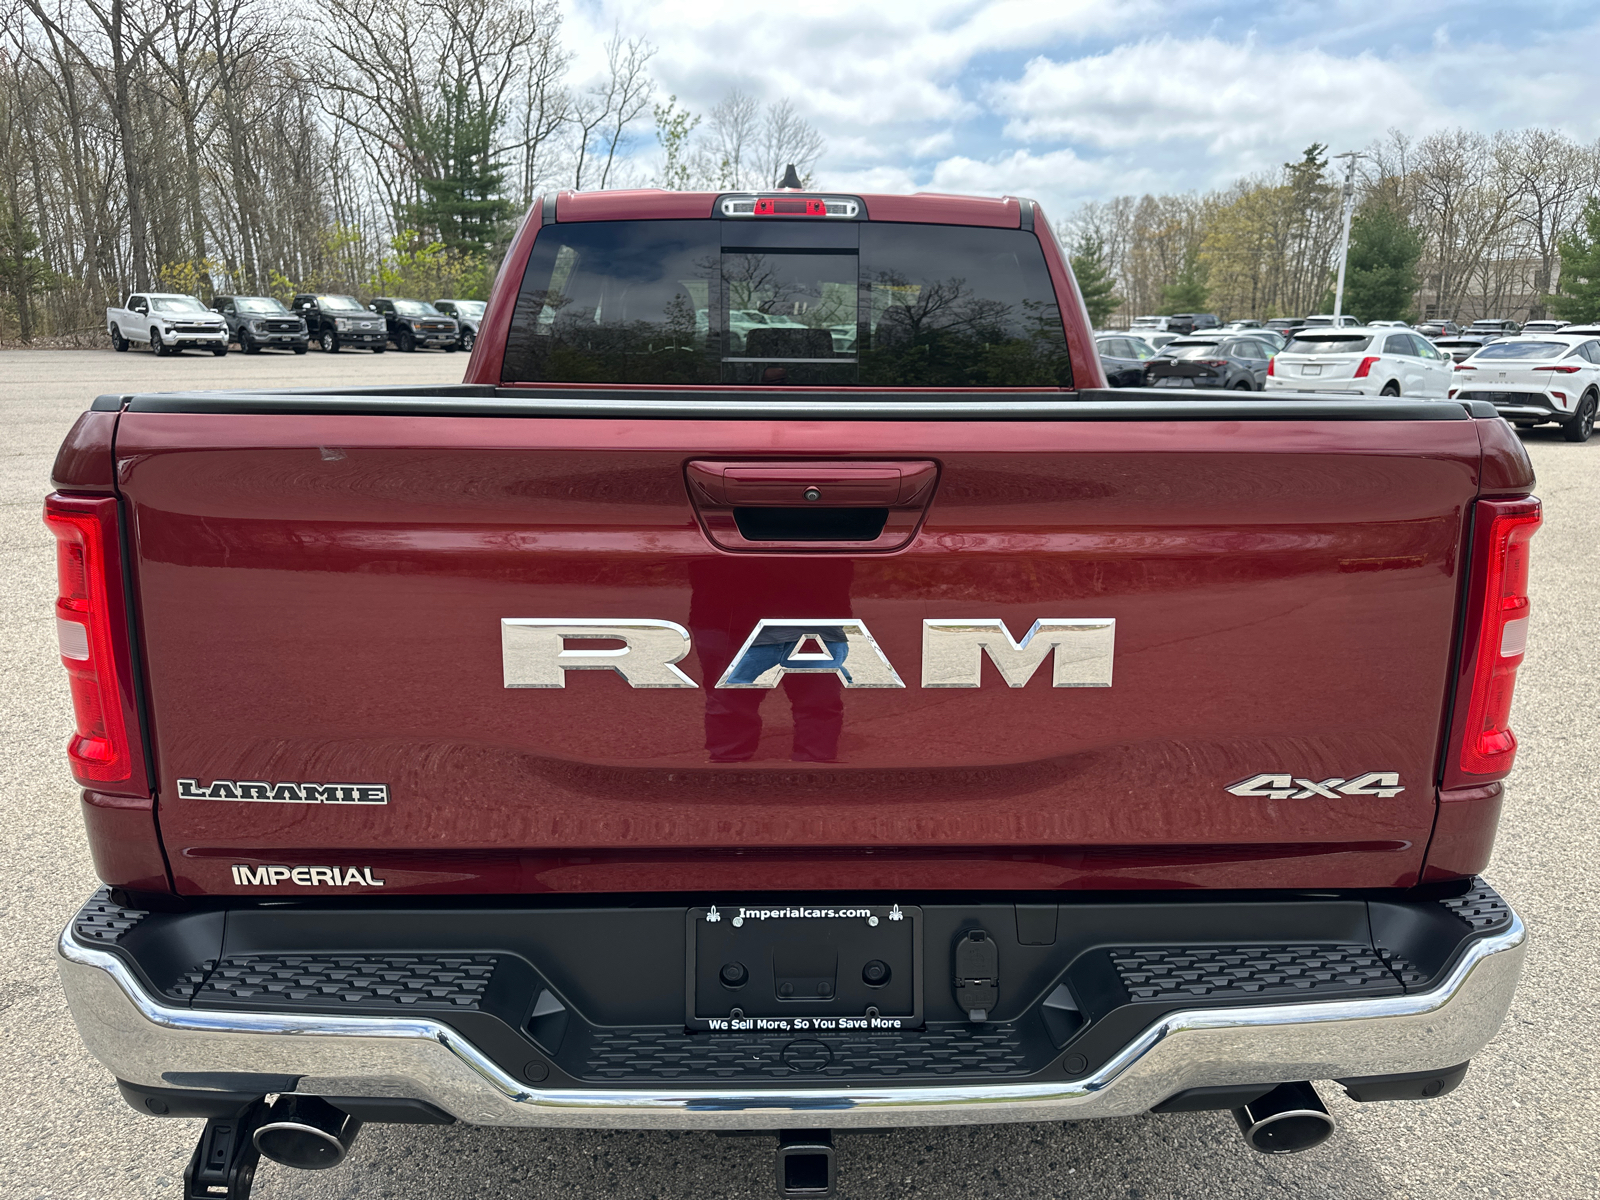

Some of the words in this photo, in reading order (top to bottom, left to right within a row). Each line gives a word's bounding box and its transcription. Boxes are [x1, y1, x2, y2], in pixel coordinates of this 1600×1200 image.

[501, 617, 1117, 689] RAM
[177, 778, 390, 805] LARAMIE
[1224, 771, 1406, 800] 4x4
[231, 864, 385, 886] IMPERIAL
[739, 907, 871, 920] Imperialcars.com
[708, 1020, 728, 1030] We
[731, 1019, 754, 1030] Sell
[757, 1019, 791, 1031] More,
[794, 1019, 810, 1029] So
[813, 1018, 836, 1029] You
[838, 1018, 868, 1029] Save
[871, 1018, 901, 1029] More
